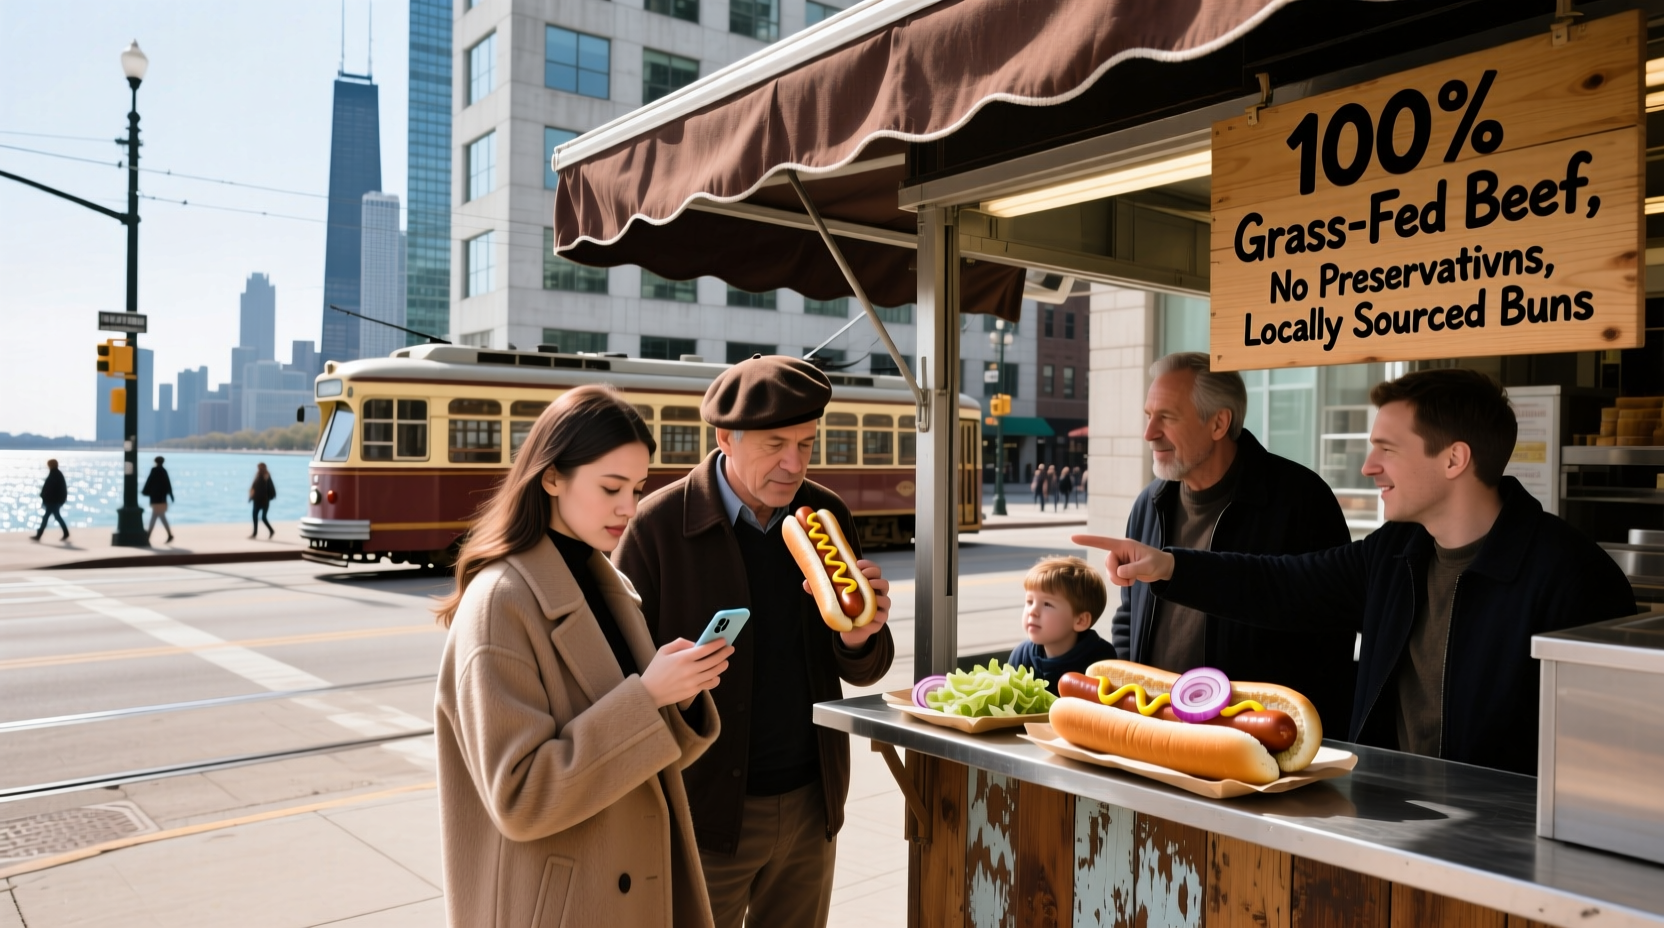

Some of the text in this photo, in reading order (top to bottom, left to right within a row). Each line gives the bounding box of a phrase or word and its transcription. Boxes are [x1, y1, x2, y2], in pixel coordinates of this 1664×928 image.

[1286, 69, 1504, 196] 100%
[1234, 150, 1601, 263] Grass-Fed Beef,
[1244, 284, 1594, 352] Locally Sourced Buns
[1270, 244, 1555, 304] No Preservativns,
